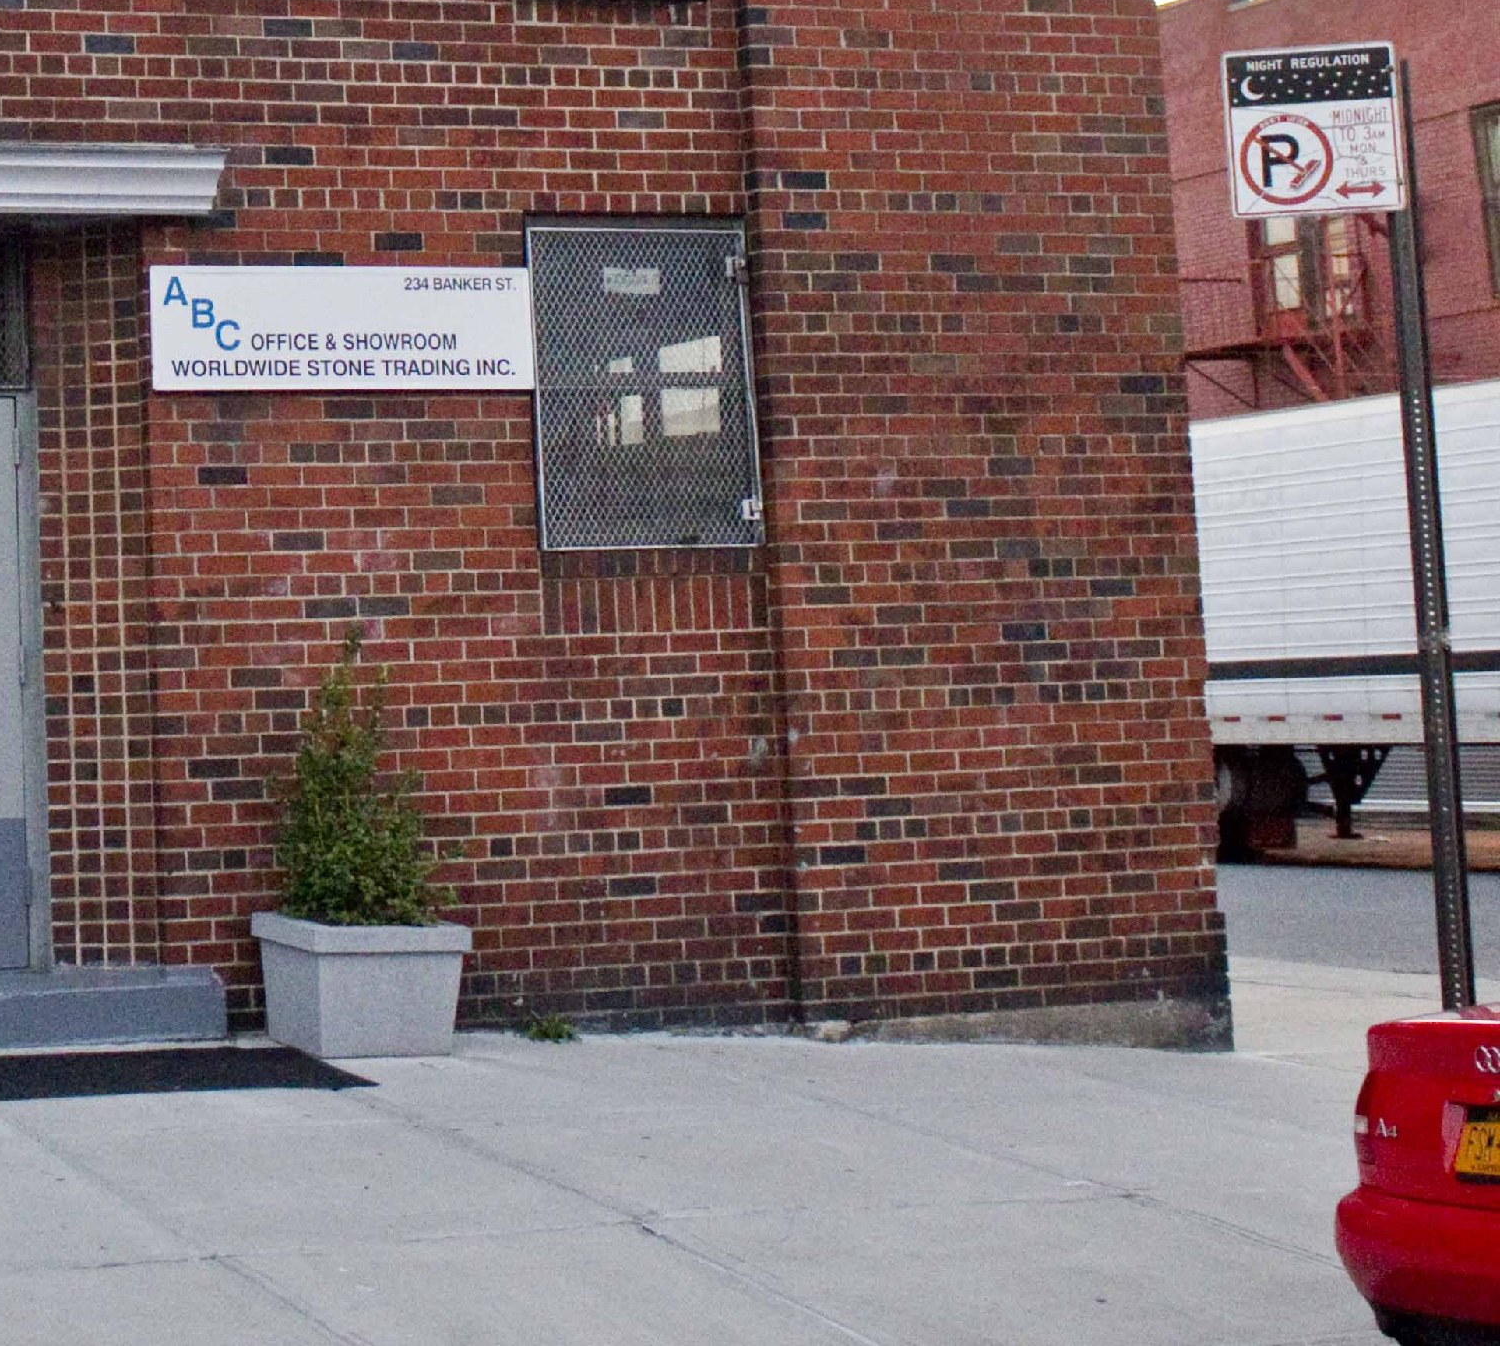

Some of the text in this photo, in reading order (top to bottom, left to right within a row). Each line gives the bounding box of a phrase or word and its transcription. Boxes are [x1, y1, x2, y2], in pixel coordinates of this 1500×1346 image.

[1245, 53, 1370, 72] NIGHT REGULATION
[1332, 107, 1387, 124] MIDNIGHT
[1339, 126, 1356, 142] TO
[1349, 142, 1376, 154] MON
[1344, 166, 1387, 179] THURS
[403, 277, 517, 291] 234 BANKER ST.
[163, 276, 241, 352] ABC
[250, 333, 457, 352] OFFICE & SHOWROOM
[171, 359, 517, 377] WORLDWIDE STONE TRADING INC.
[1375, 1117, 1398, 1139] A4
